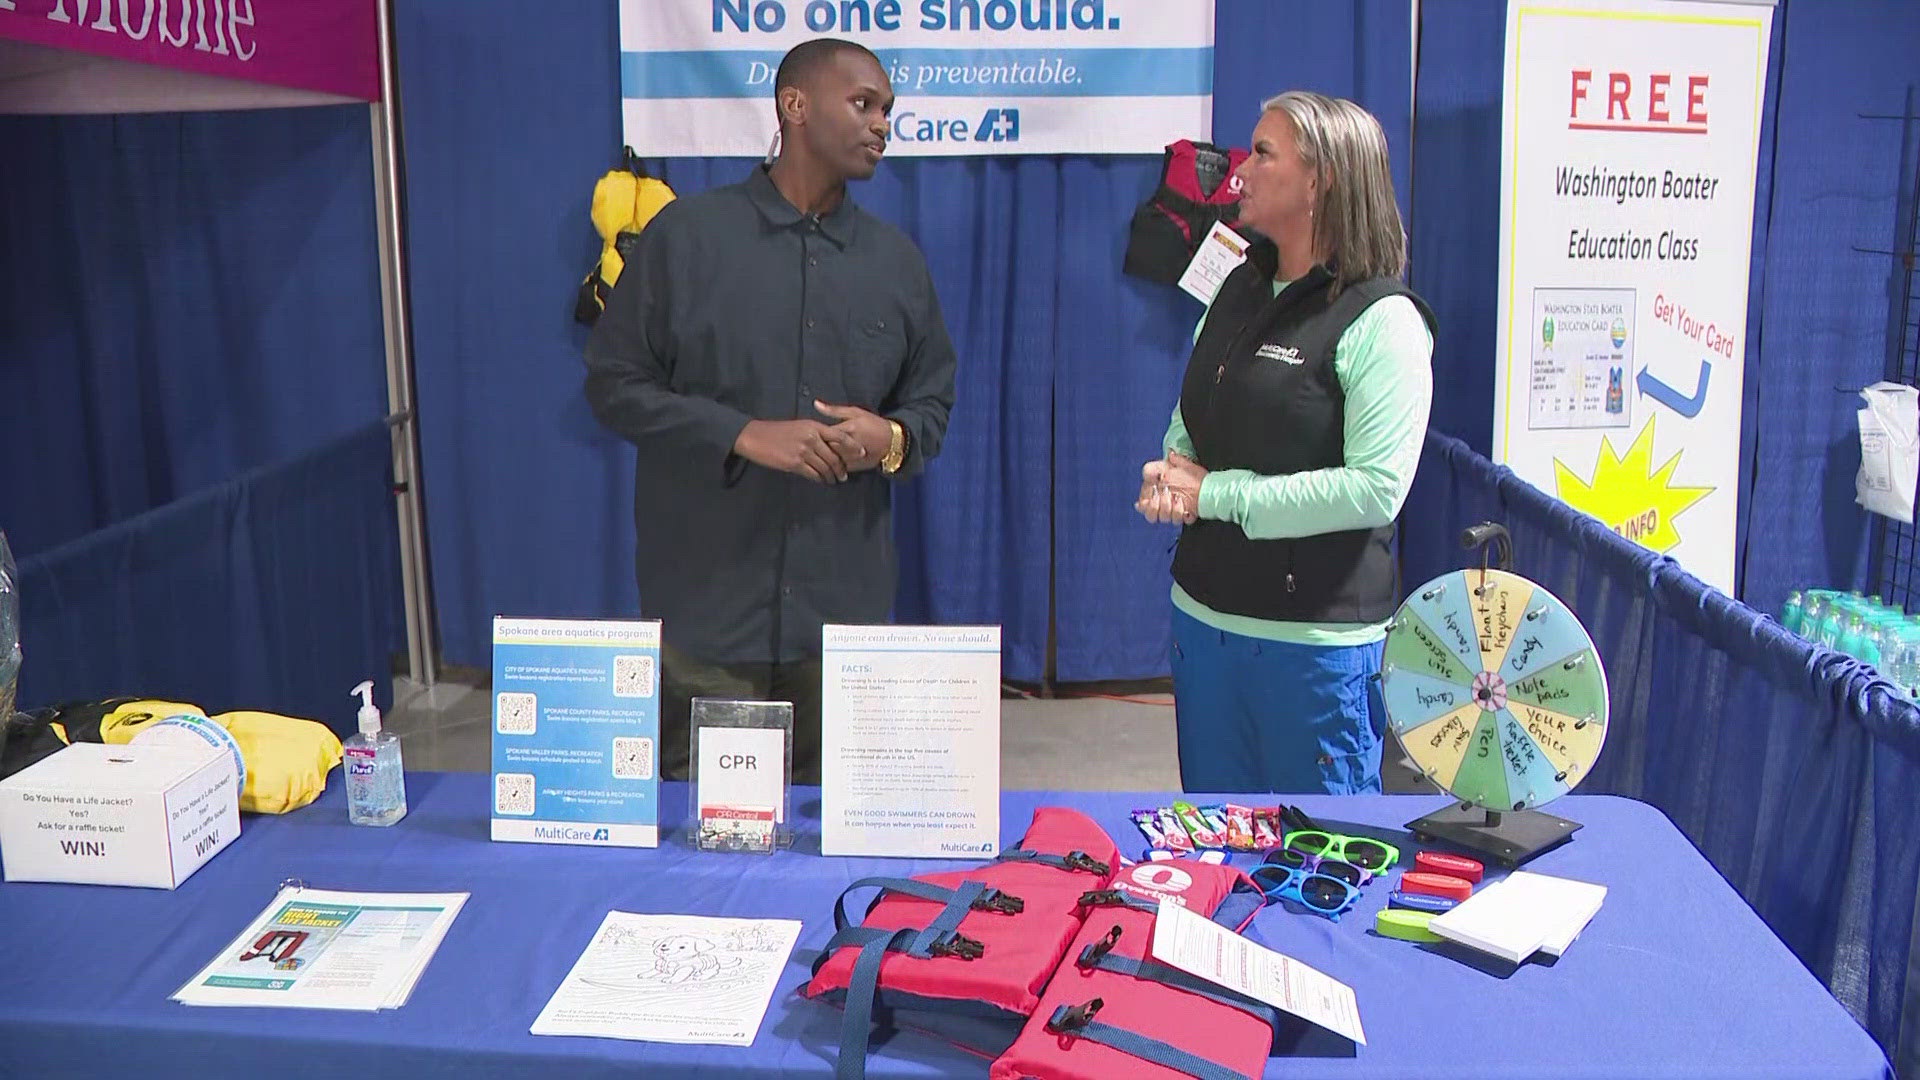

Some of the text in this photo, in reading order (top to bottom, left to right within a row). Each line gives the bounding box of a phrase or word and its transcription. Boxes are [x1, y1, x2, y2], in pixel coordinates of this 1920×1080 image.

[710, 0, 1121, 33] No one should.
[890, 58, 1083, 88] is preventable.
[1570, 70, 1709, 124] FREE
[884, 109, 968, 142] iCare
[1555, 165, 1719, 204] Washington Boater
[1568, 228, 1698, 261] Education Class
[1654, 294, 1735, 359] Get Your Card
[1626, 509, 1657, 541] INFO
[498, 625, 654, 640] Spokane area aquatics programs
[830, 633, 866, 644] Anyone
[886, 633, 921, 642] drown.
[923, 634, 935, 642] No
[957, 634, 992, 643] should.
[841, 664, 872, 674] FACTS:
[1515, 677, 1549, 696] Note
[720, 754, 757, 770] CPR
[22, 793, 34, 802] Do
[36, 794, 52, 803] You
[53, 795, 74, 804] Have
[83, 796, 98, 805] Life
[100, 797, 134, 806] Jacket?
[172, 811, 180, 821] Do
[180, 806, 190, 815] You
[189, 797, 201, 808] Have
[204, 788, 214, 798] Life
[68, 810, 89, 818] Yes?
[37, 822, 53, 830] Ask
[54, 822, 66, 830] for
[76, 823, 97, 832] raffle
[98, 825, 125, 834] ticket!
[533, 827, 591, 840] MultiCare
[865, 820, 891, 829] happen
[182, 832, 192, 842] Ask
[195, 829, 220, 858] WIN!
[60, 840, 106, 857] WIN!
[940, 843, 980, 853] MultiCare
[1113, 881, 1187, 907] Overton's
